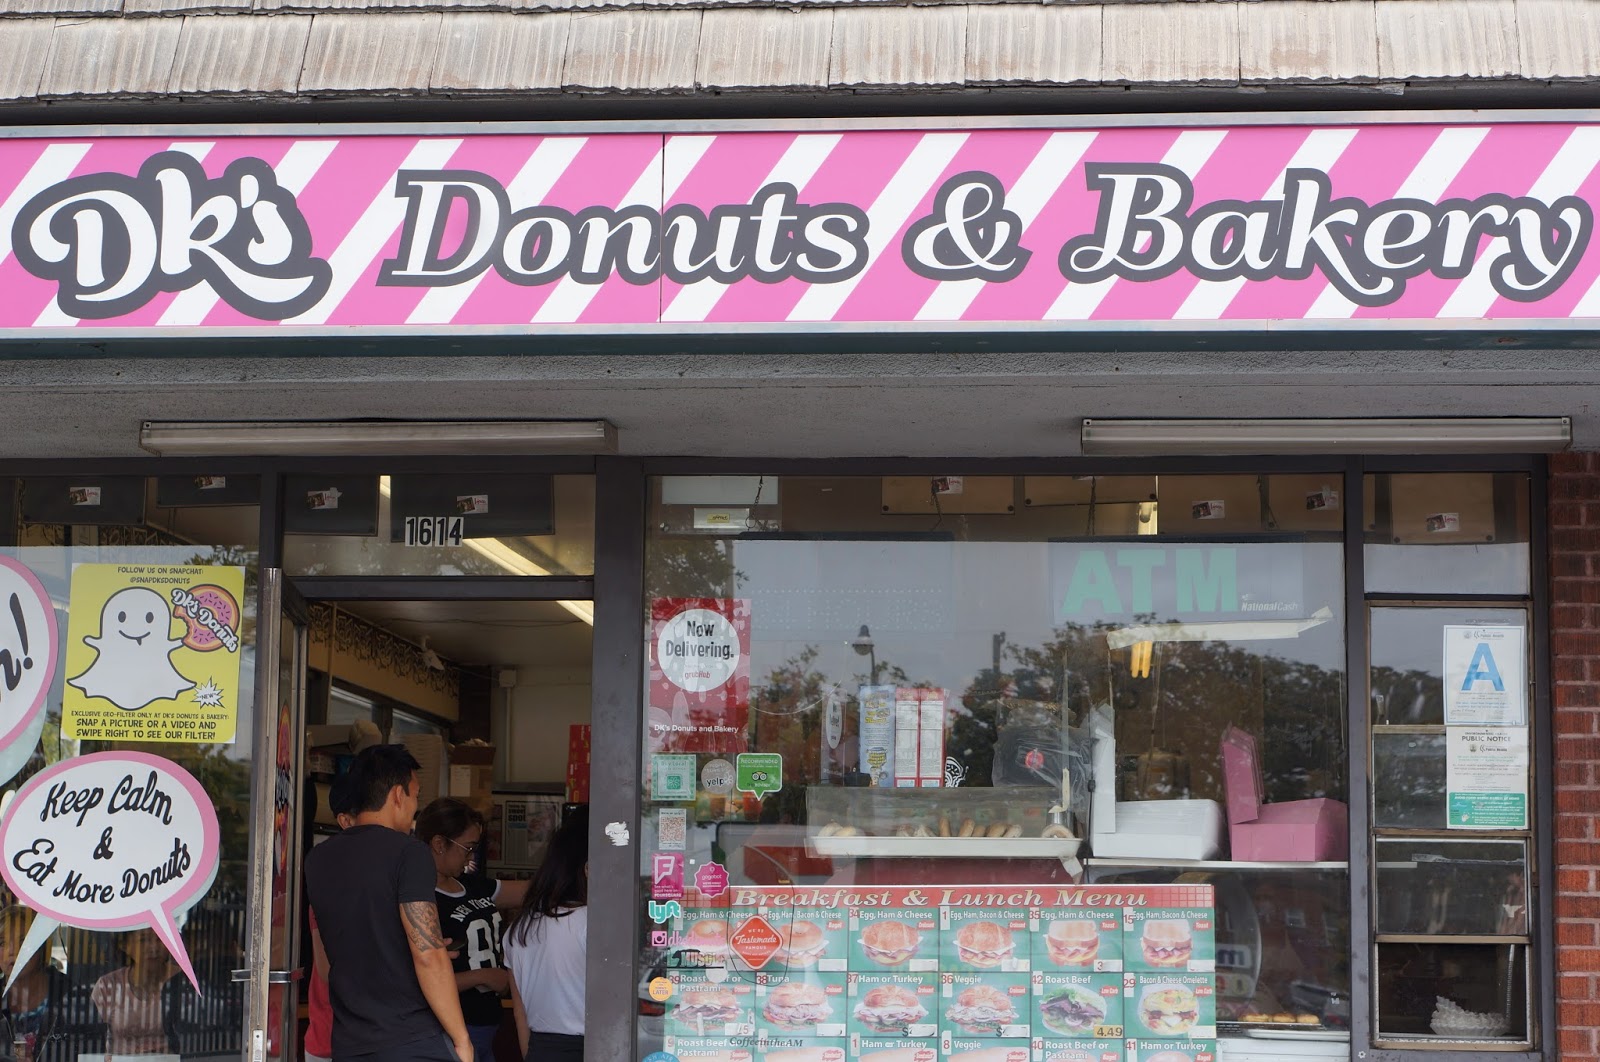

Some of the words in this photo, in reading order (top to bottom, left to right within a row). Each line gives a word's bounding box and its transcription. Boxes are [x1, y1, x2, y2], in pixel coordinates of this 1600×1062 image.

[30, 166, 314, 301] Dk's
[392, 181, 865, 275] Donuts
[913, 182, 1016, 270] &
[1070, 174, 1581, 295] Bakery
[406, 518, 462, 545] 1614
[117, 566, 145, 574] FOLLOW
[129, 576, 191, 584] @SNAPDKSDONUTS
[1061, 548, 1239, 614] ATM
[197, 608, 239, 653] Donuts
[686, 620, 715, 637] Now
[665, 639, 734, 660] Delivering.
[1460, 642, 1505, 692] A
[76, 718, 99, 727] SNAP
[101, 719, 107, 727] A
[109, 719, 144, 728] PICTURE
[147, 720, 159, 728] OR
[161, 720, 167, 728] A
[170, 720, 196, 729] VIDEO
[198, 721, 217, 729] AND
[76, 728, 102, 737] SWIPE
[105, 729, 130, 738] RIGHT
[133, 730, 144, 738] TO
[147, 730, 162, 739] SEE
[165, 730, 182, 739] OUR
[185, 731, 216, 740] FILTER!
[671, 724, 698, 733] Donuts
[699, 724, 714, 733] and
[714, 725, 739, 735] Bakery
[706, 777, 725, 787] yelp
[40, 781, 104, 827] Keep
[107, 770, 173, 825] Calm
[93, 826, 114, 860] &
[12, 838, 58, 887] Eat
[53, 870, 114, 903] More
[120, 837, 191, 898] Donuts
[732, 889, 892, 909] Breakfast
[902, 889, 929, 906] &
[938, 889, 1044, 907] Lunch
[1053, 889, 1148, 907] Menu
[450, 904, 473, 923] NEW
[648, 900, 681, 924] lyft
[683, 911, 699, 920] Egg,
[726, 911, 753, 919] Cheese
[796, 911, 816, 919] Bacon
[816, 911, 820, 919] &
[820, 911, 842, 919] Cheese
[859, 910, 876, 921] Egg,
[877, 910, 896, 919] Ham
[896, 910, 903, 919] &
[904, 910, 933, 919] Cheese
[980, 911, 997, 919] Bacon
[997, 911, 1002, 919] &
[1003, 911, 1025, 919] Cheese
[1040, 910, 1057, 921] Egg,
[1058, 910, 1077, 919] Ham
[1078, 910, 1085, 919] &
[1086, 910, 1114, 919] Cheese
[1162, 910, 1180, 919] Bacon
[1180, 910, 1186, 919] &
[1186, 910, 1208, 919] Cheese
[735, 934, 778, 945] Tastemade
[680, 974, 706, 982] Roast
[766, 974, 790, 983] Tuna
[858, 975, 880, 983] Ham
[892, 975, 924, 985] Turkey
[954, 975, 982, 985] Veggie
[1045, 975, 1070, 984] Roast
[1071, 975, 1092, 984] Beef
[1139, 976, 1157, 984] Bacon
[1162, 976, 1182, 984] Cheese
[1182, 976, 1208, 984] Omelette
[680, 984, 722, 992] Pastrami
[1096, 1027, 1123, 1037] 4.49
[677, 1038, 704, 1047] Roast
[706, 1038, 728, 1047] Beef
[861, 1040, 883, 1048] Ham
[896, 1040, 927, 1050] Turkey
[953, 1041, 982, 1051] Veggie
[1045, 1041, 1072, 1049] Roast
[1074, 1041, 1096, 1049] Beef
[1140, 1042, 1162, 1050] Ham
[1175, 1042, 1207, 1052] Turkey
[677, 1048, 719, 1057] Pastrami
[1045, 1051, 1088, 1059] Pastrami
